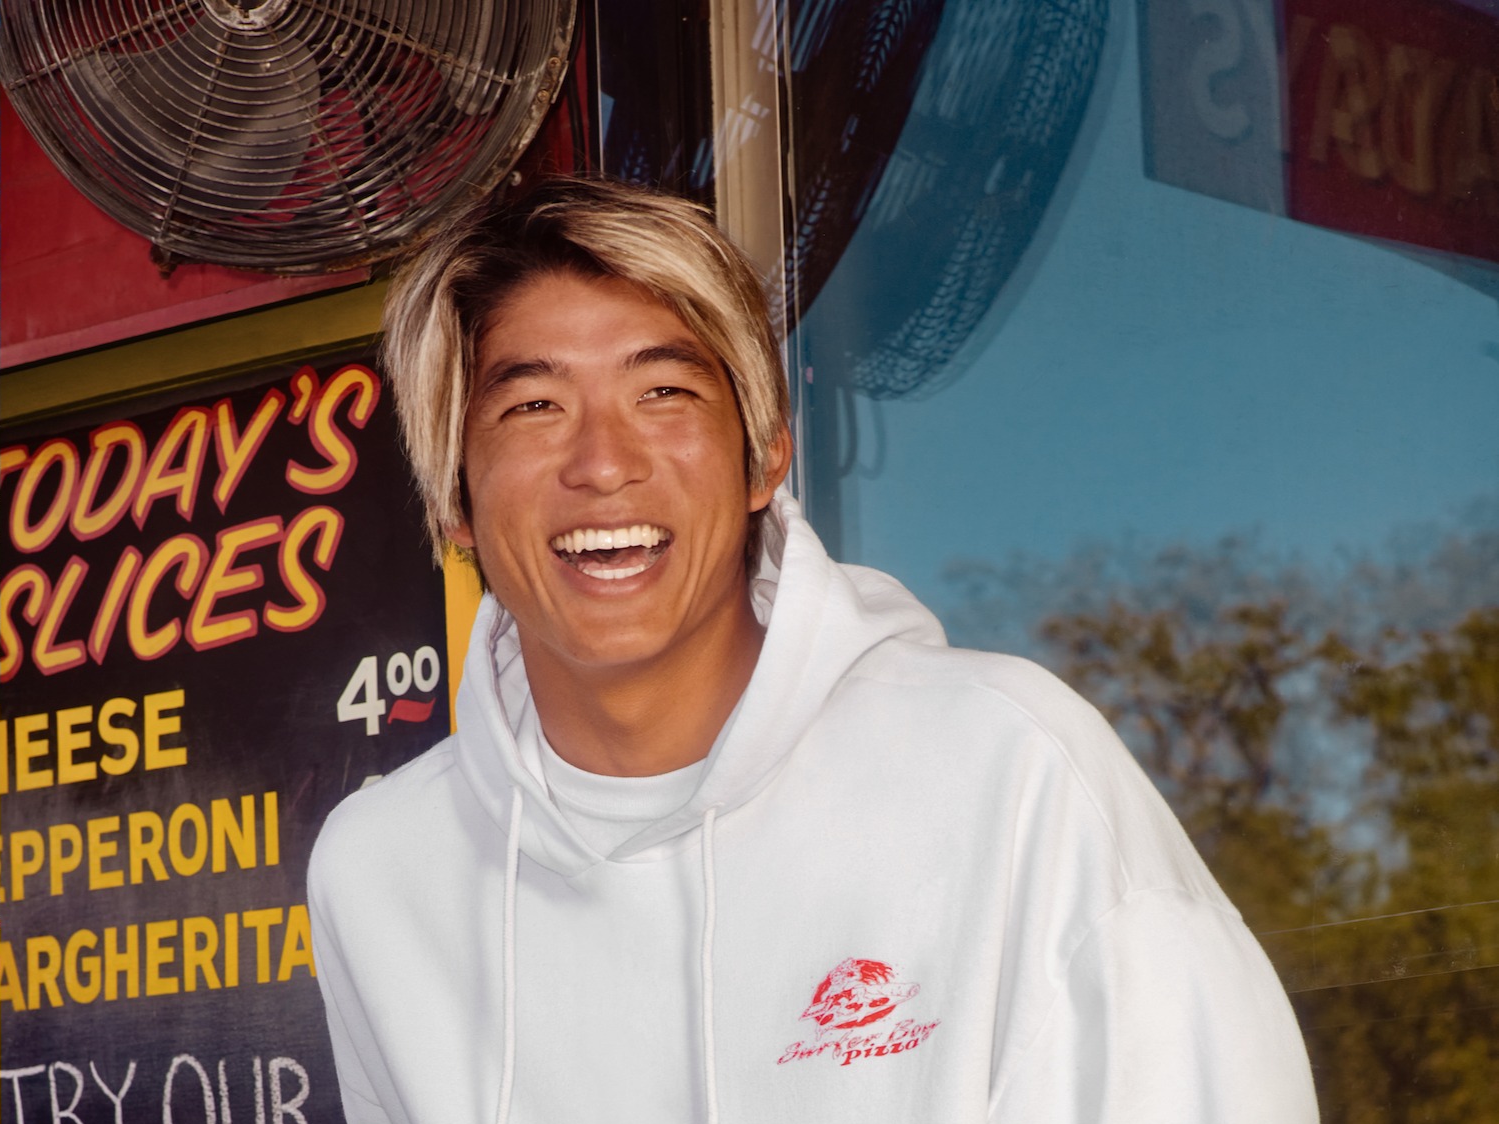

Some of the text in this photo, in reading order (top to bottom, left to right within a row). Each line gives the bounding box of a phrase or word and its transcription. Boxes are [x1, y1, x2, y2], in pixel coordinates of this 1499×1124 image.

[0, 689, 188, 795] EESE
[0, 791, 280, 904] PPERONI
[776, 1018, 942, 1066] Surfer Boy
